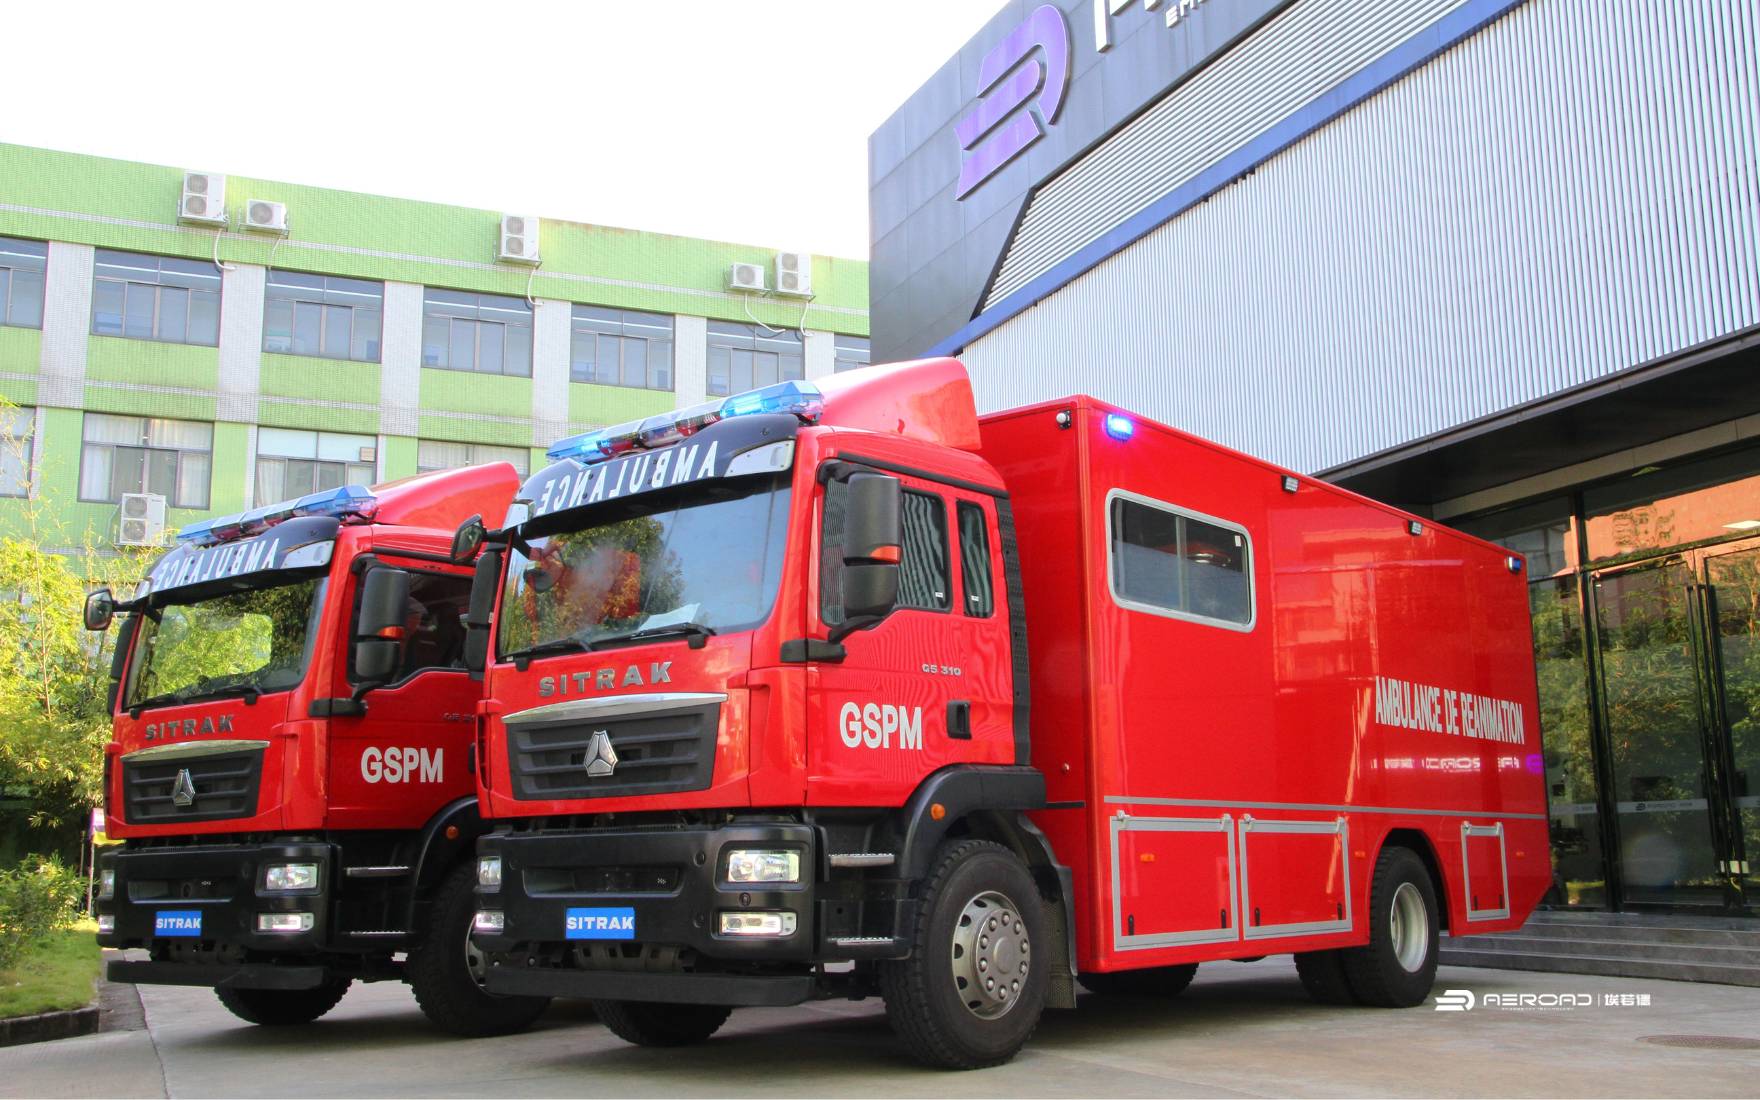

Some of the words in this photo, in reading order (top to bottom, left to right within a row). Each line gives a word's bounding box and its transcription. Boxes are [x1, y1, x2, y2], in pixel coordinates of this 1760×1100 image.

[539, 661, 673, 697] SITRAK
[940, 665, 962, 676] 310
[1375, 675, 1443, 734] AMBULANCE
[1443, 688, 1460, 736] DE
[1460, 691, 1525, 745] REANIMATION
[145, 714, 235, 740] SITRAK
[839, 701, 923, 751] GSPM
[360, 746, 444, 784] GSPM
[155, 917, 202, 929] SITRAK
[566, 916, 635, 931] SITRAK
